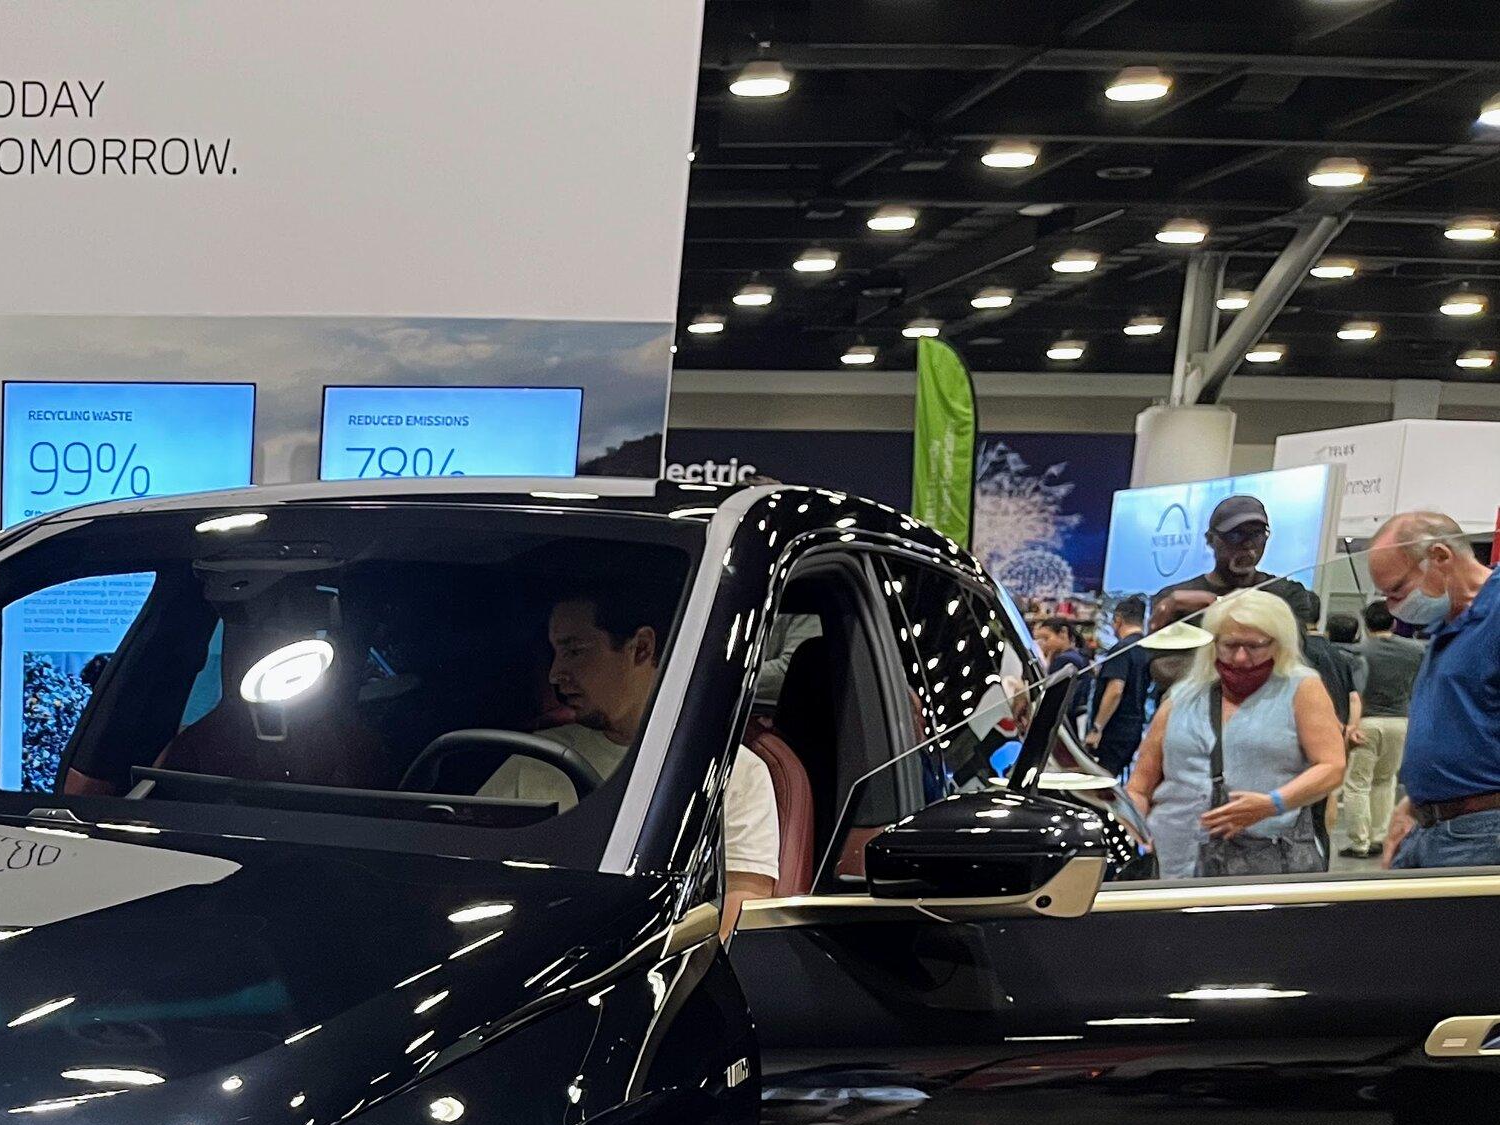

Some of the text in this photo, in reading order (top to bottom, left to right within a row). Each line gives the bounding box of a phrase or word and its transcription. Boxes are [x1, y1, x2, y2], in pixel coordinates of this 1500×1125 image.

[28, 410, 133, 422] RECYCLING WASTE
[348, 414, 470, 427] REDUCED EMISSIONS
[29, 441, 151, 497] 99%
